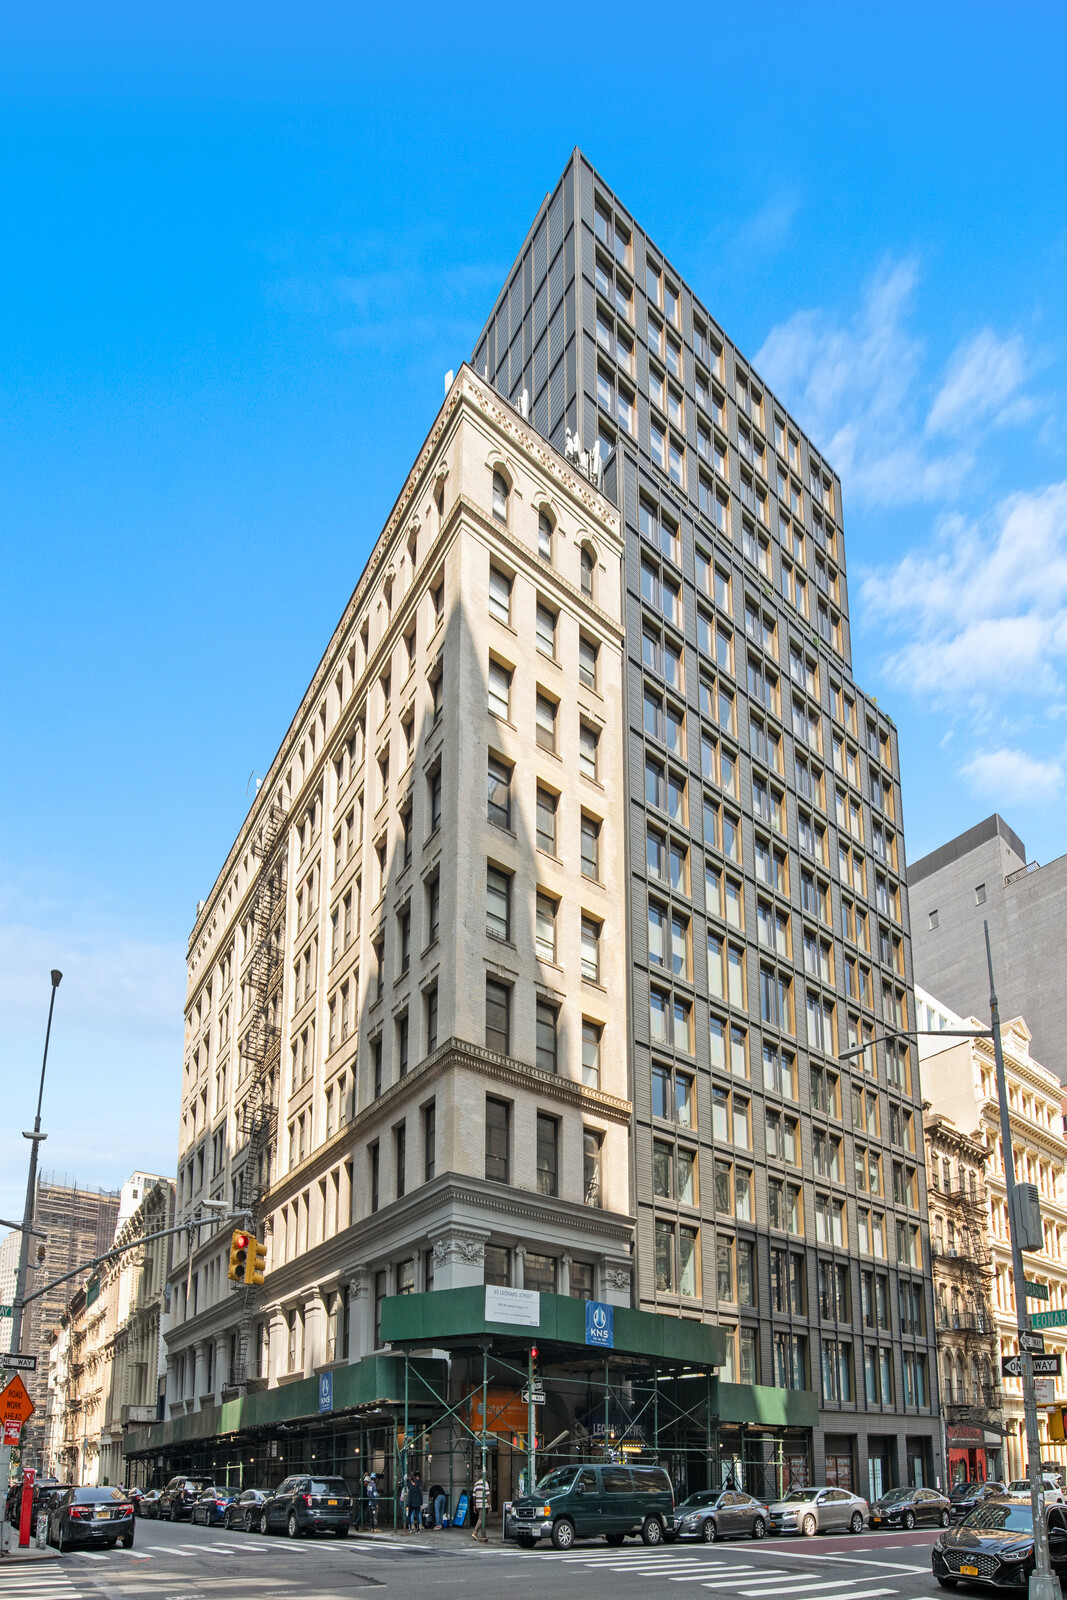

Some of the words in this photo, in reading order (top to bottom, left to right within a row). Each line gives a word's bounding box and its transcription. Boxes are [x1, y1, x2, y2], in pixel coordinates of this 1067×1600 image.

[590, 1328, 609, 1339] KNS
[18, 1359, 32, 1367] WAY
[1010, 1361, 1021, 1371] ON
[1034, 1361, 1054, 1371] WAY
[8, 1390, 23, 1399] ROAD
[7, 1401, 21, 1410] WORK
[4, 1412, 22, 1421] AHEAD
